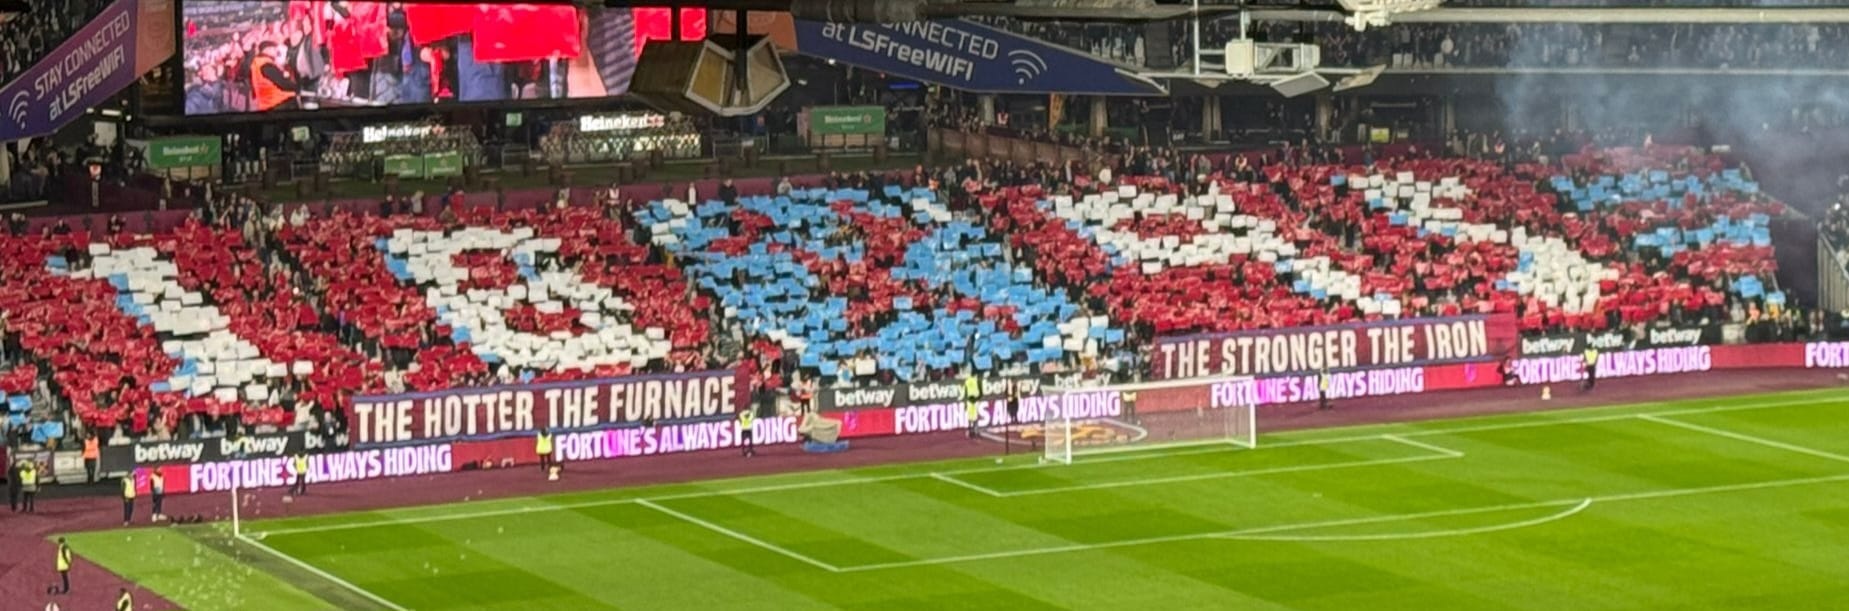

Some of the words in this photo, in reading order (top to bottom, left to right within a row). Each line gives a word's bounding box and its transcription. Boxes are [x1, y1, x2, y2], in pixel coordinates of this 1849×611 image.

[822, 21, 844, 42] at
[34, 60, 67, 100] STAY
[65, 10, 131, 77] CONNECTED
[49, 95, 63, 121] at
[580, 113, 649, 132] Heineken
[1161, 340, 1212, 379] THE
[1221, 328, 1357, 376] STRONGER
[1367, 325, 1415, 364] THE
[1424, 320, 1487, 360] IRON
[1650, 328, 1702, 345] betway
[1595, 350, 1656, 379] ALWAYS
[1657, 345, 1711, 373] HIDING
[834, 389, 895, 407] betway
[909, 383, 965, 401] betway
[1368, 366, 1424, 395] HIDING
[354, 399, 414, 443] THE
[424, 390, 534, 439] HOTTER
[545, 385, 600, 429] THE
[609, 375, 736, 423] FURNACE
[134, 441, 204, 463] betway
[555, 427, 657, 462] FORTUNE'S
[659, 421, 733, 453] ALWAYS
[190, 455, 298, 493] FORTUNE'S
[304, 450, 386, 484] ALWAYS
[384, 443, 452, 477] HIDING
